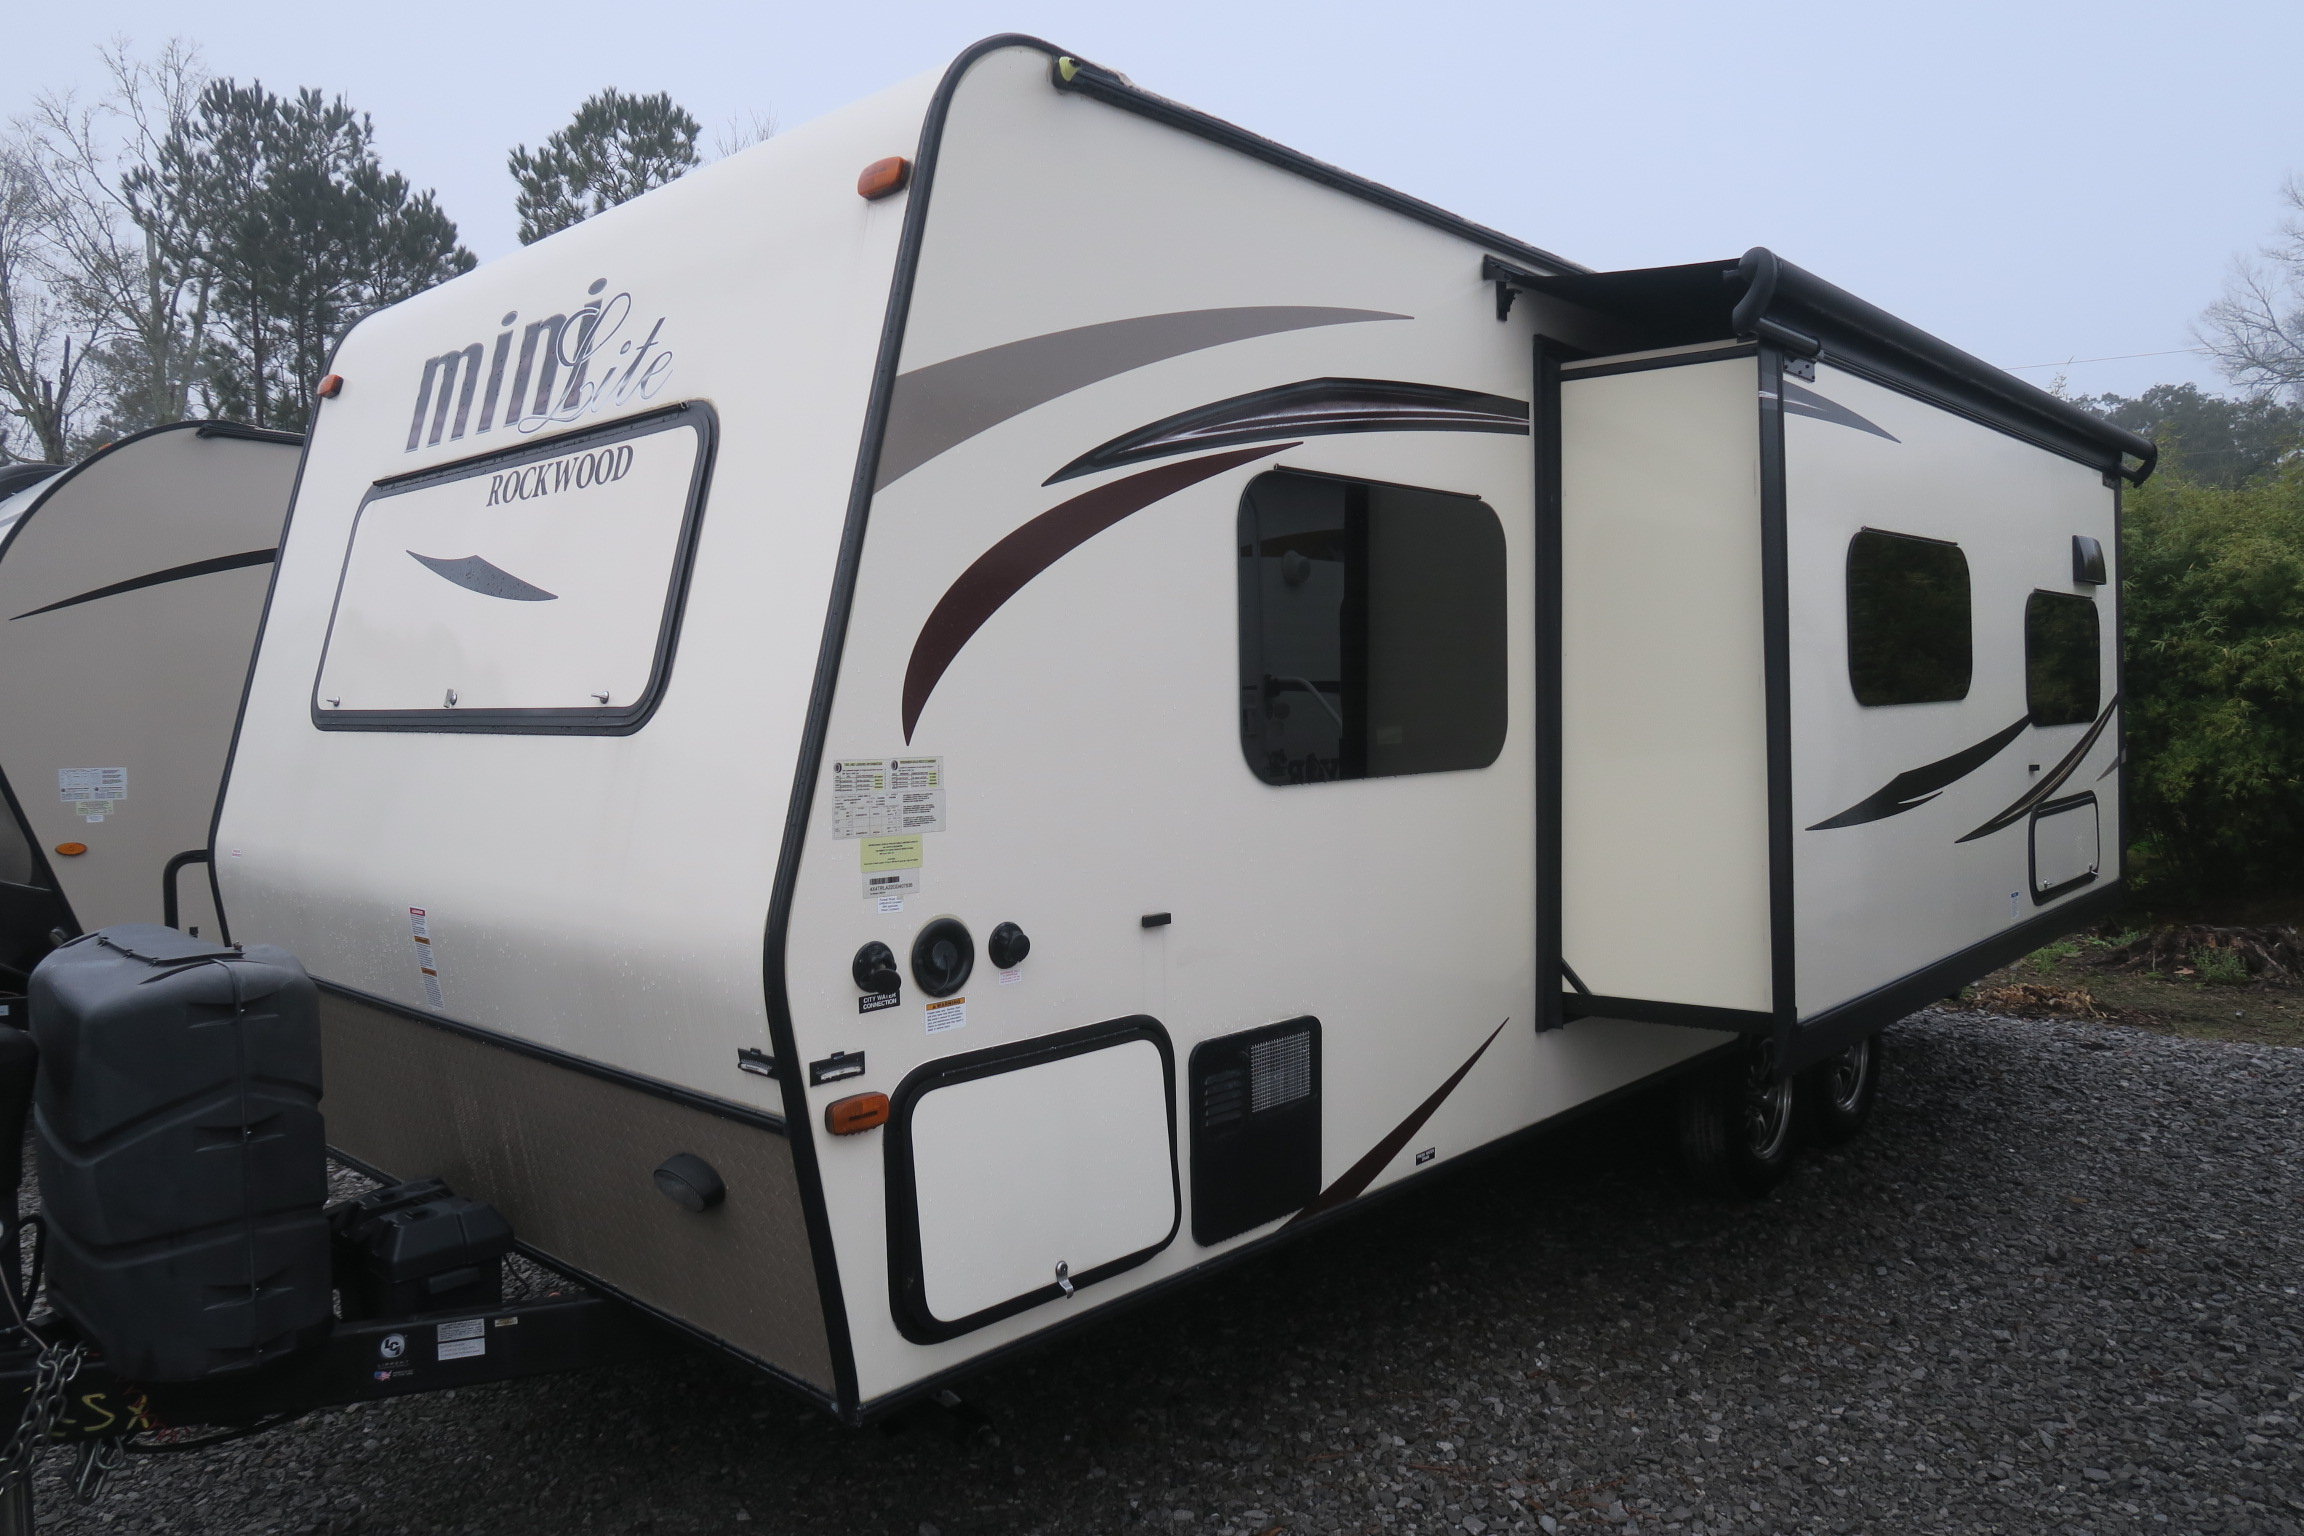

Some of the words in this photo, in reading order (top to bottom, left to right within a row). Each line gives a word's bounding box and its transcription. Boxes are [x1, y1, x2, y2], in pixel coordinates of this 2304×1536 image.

[405, 278, 607, 453] mini
[518, 292, 673, 434] Lite
[486, 445, 634, 507] ROCKWOOD
[863, 999, 897, 1010] CONNECTION
[936, 998, 961, 1009] WARNING
